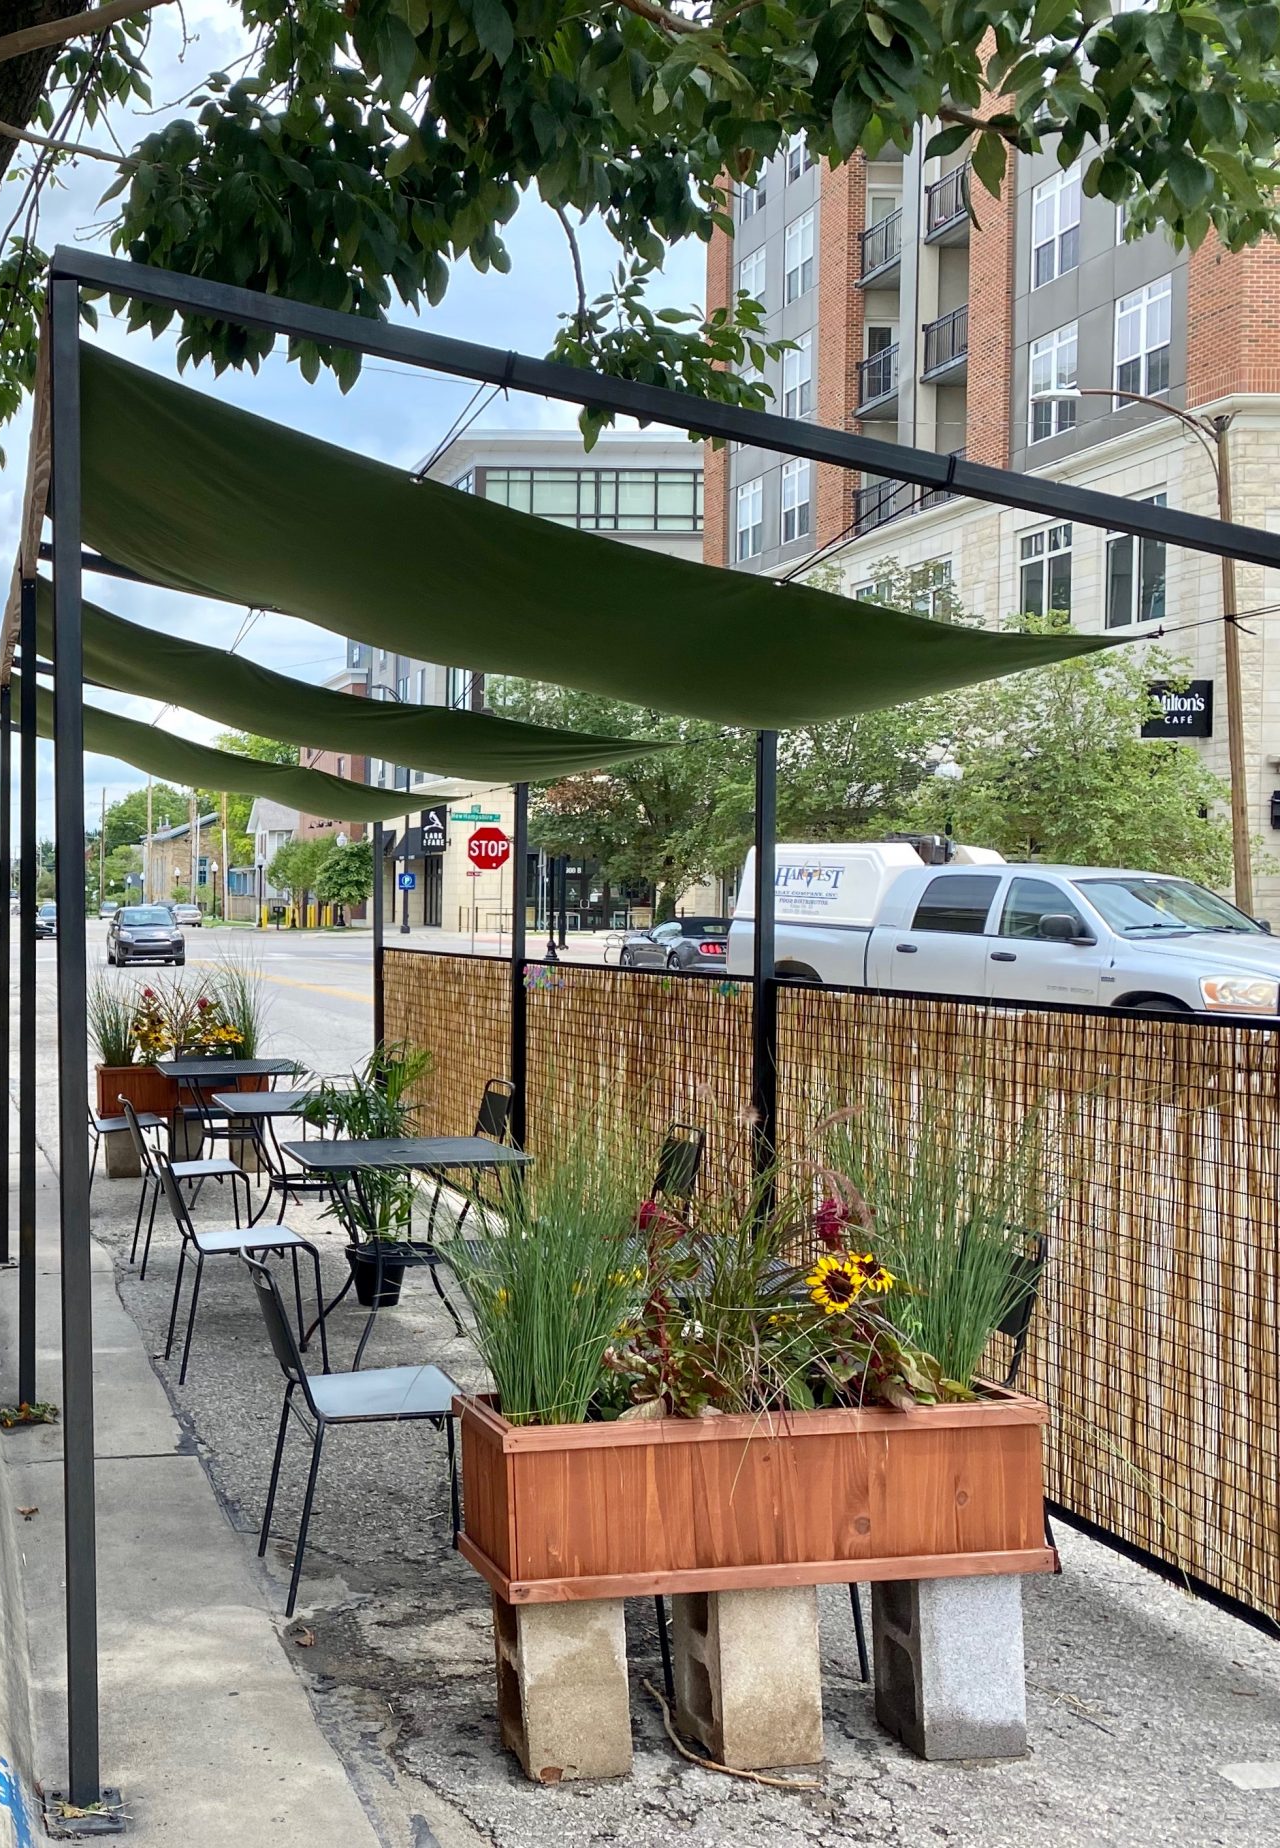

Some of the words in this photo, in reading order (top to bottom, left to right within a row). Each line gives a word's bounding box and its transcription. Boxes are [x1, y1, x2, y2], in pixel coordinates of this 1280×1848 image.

[1164, 714, 1193, 724] CAFÉ
[425, 832, 442, 840] LARK
[469, 840, 508, 857] STOP
[775, 867, 844, 888] HARVEST
